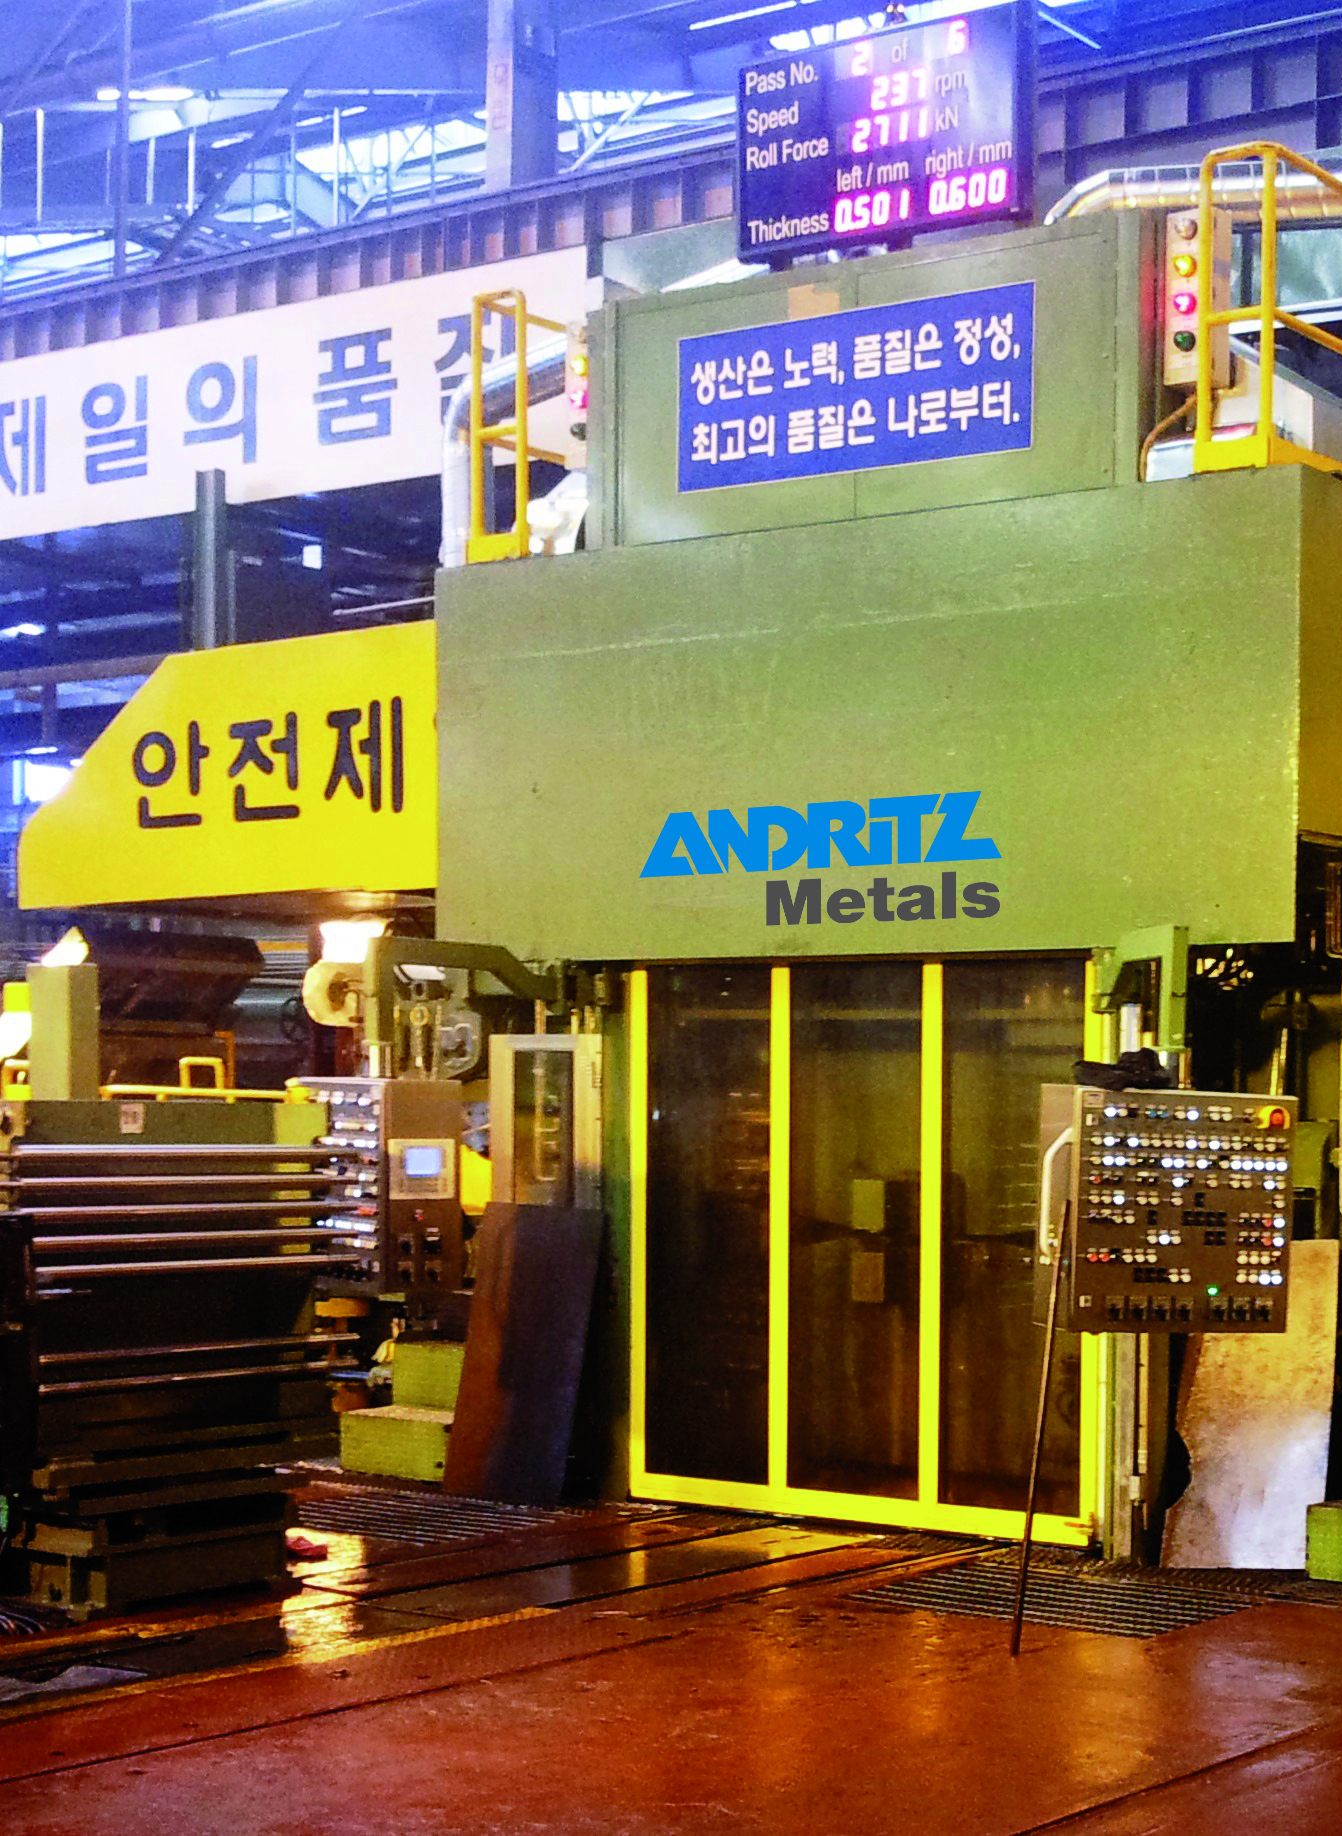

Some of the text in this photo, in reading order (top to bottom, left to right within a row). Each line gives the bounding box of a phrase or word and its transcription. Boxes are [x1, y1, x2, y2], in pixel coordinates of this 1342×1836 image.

[745, 19, 968, 96] Pass No. 2 of 6
[746, 67, 968, 137] Speed 237 rpm
[746, 105, 959, 172] Roll Force 2711 kN
[748, 212, 830, 245] Thickness
[690, 312, 1021, 405] 생산은 노력, 품질은 정성,
[690, 380, 1021, 465] 최고의 품질은 나로부터.
[132, 695, 437, 829] 안전제
